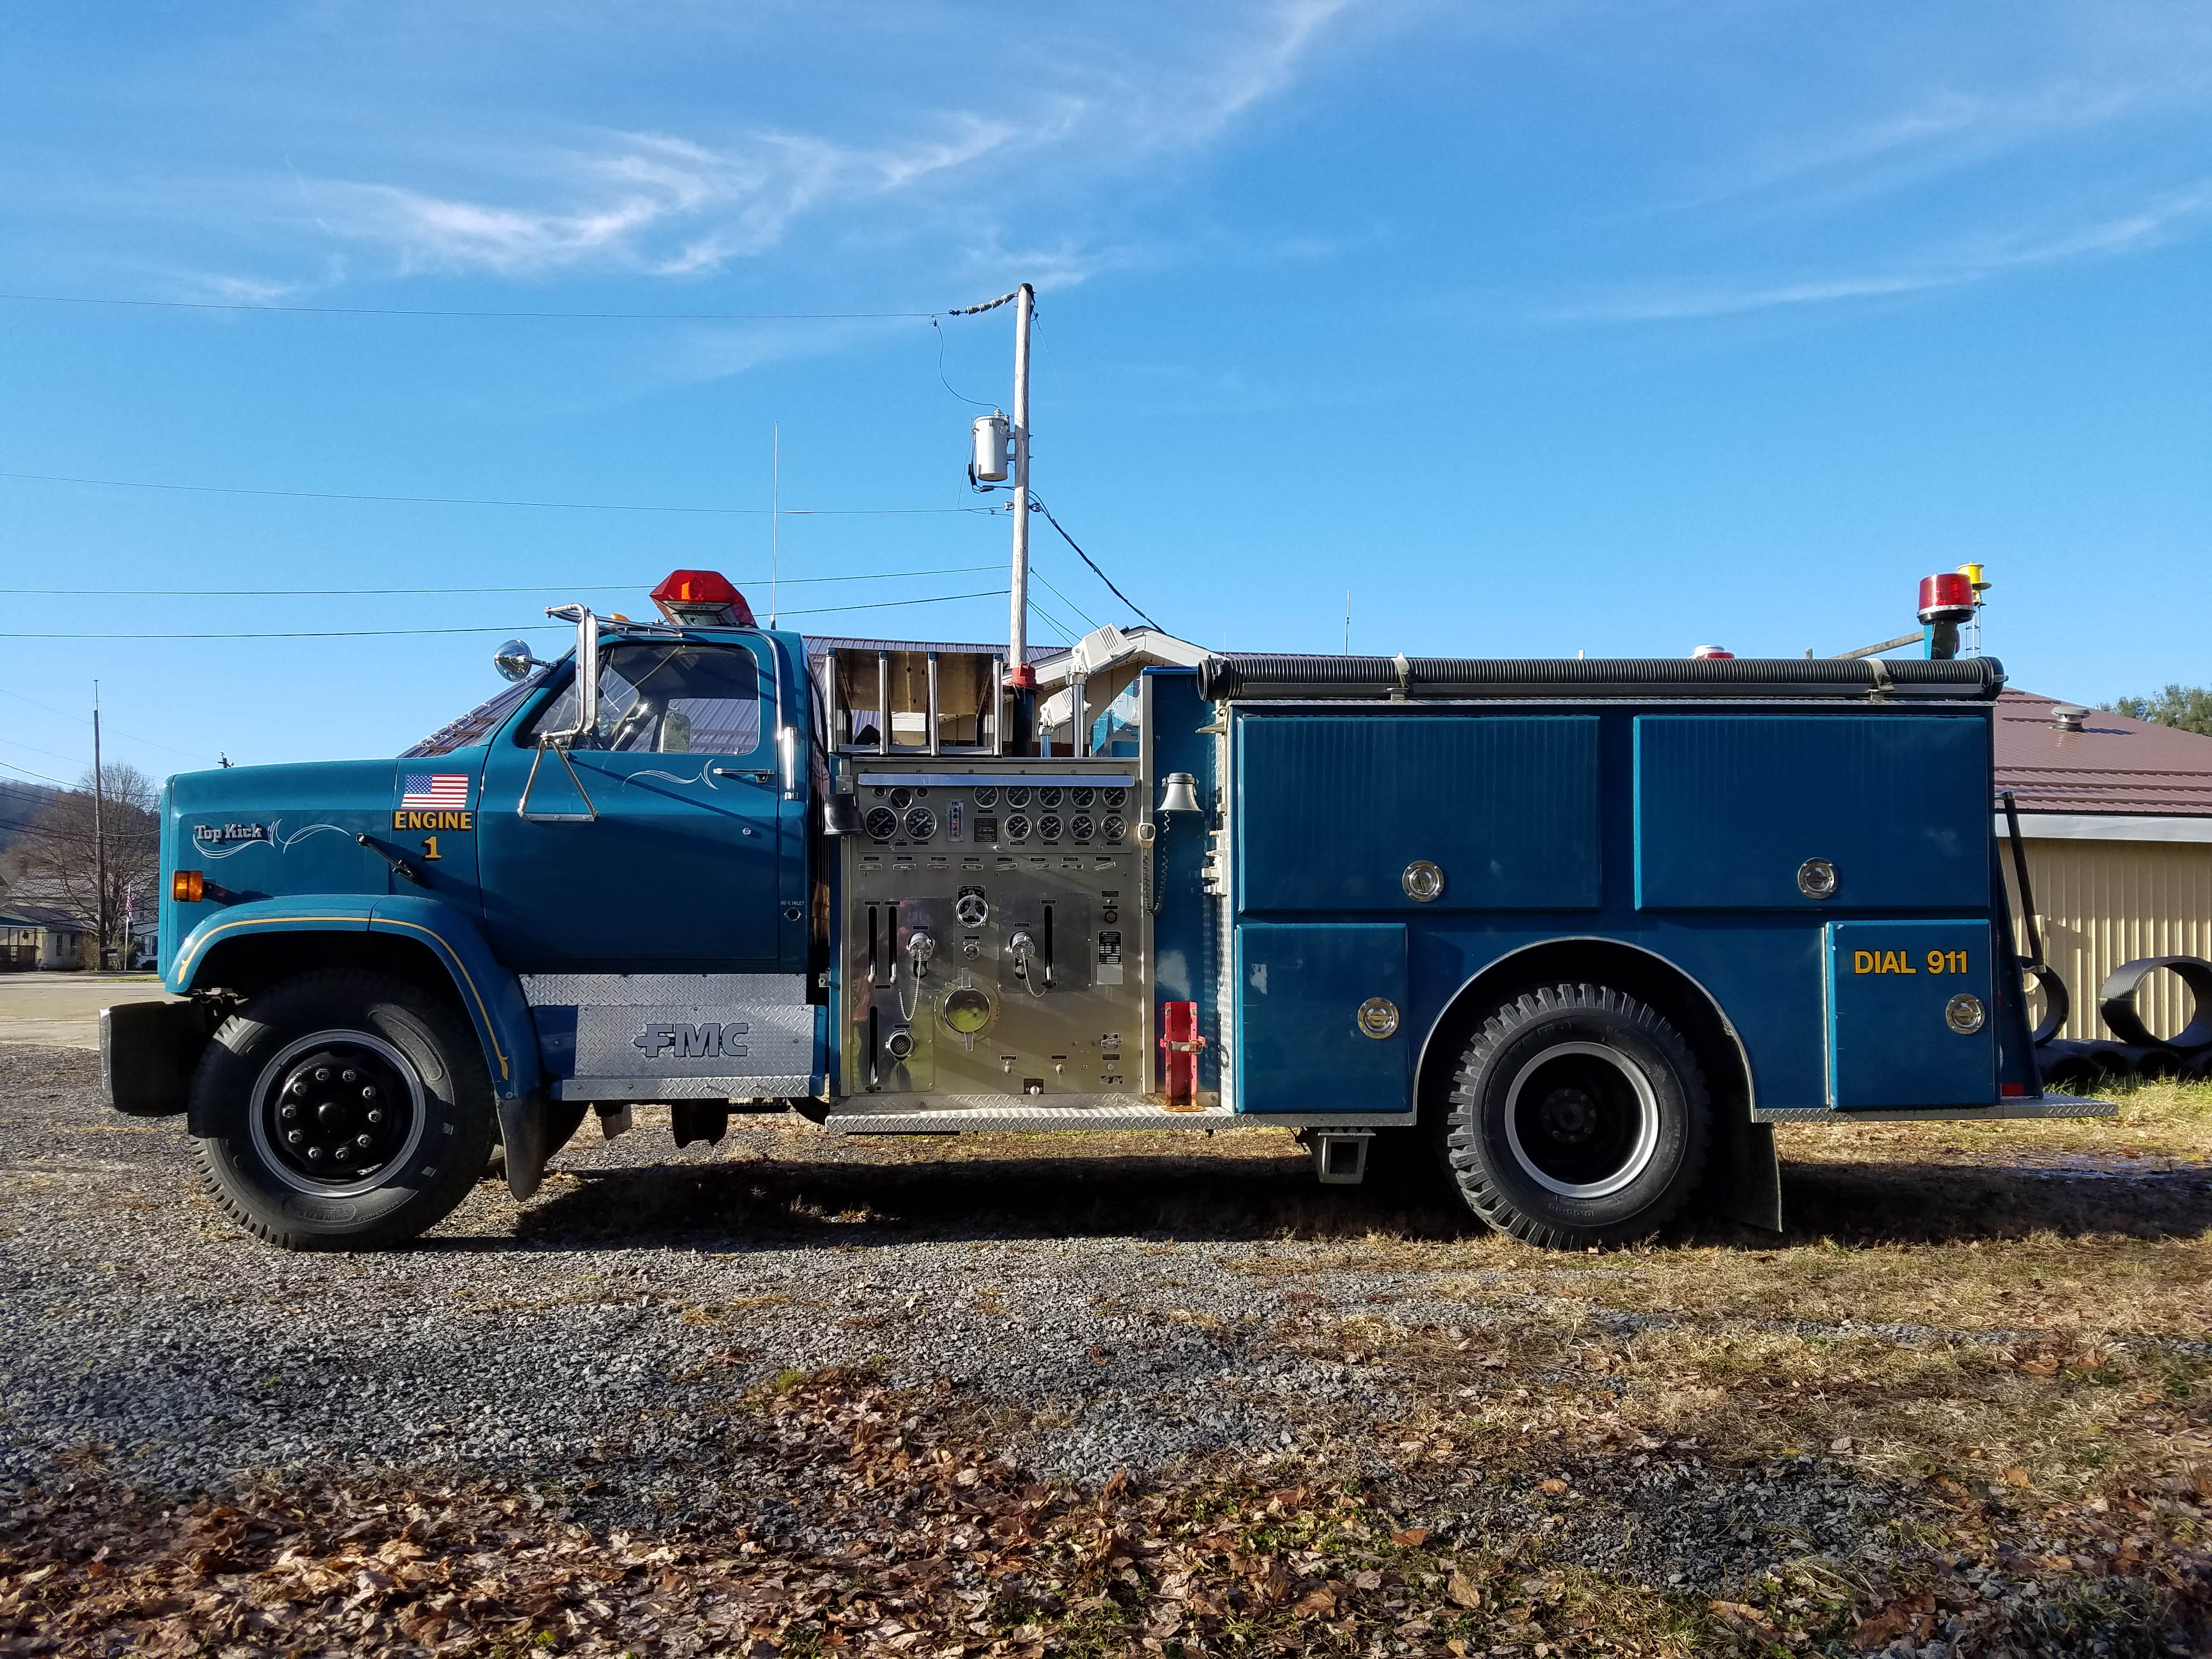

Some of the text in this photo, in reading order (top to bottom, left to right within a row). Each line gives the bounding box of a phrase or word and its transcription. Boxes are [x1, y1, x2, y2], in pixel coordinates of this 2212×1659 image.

[394, 811, 472, 830] ENGINE
[194, 823, 262, 843] Top Kick
[423, 836, 442, 859] 1
[1854, 950, 1967, 974] DIAL 911
[634, 1023, 748, 1057] FMC
